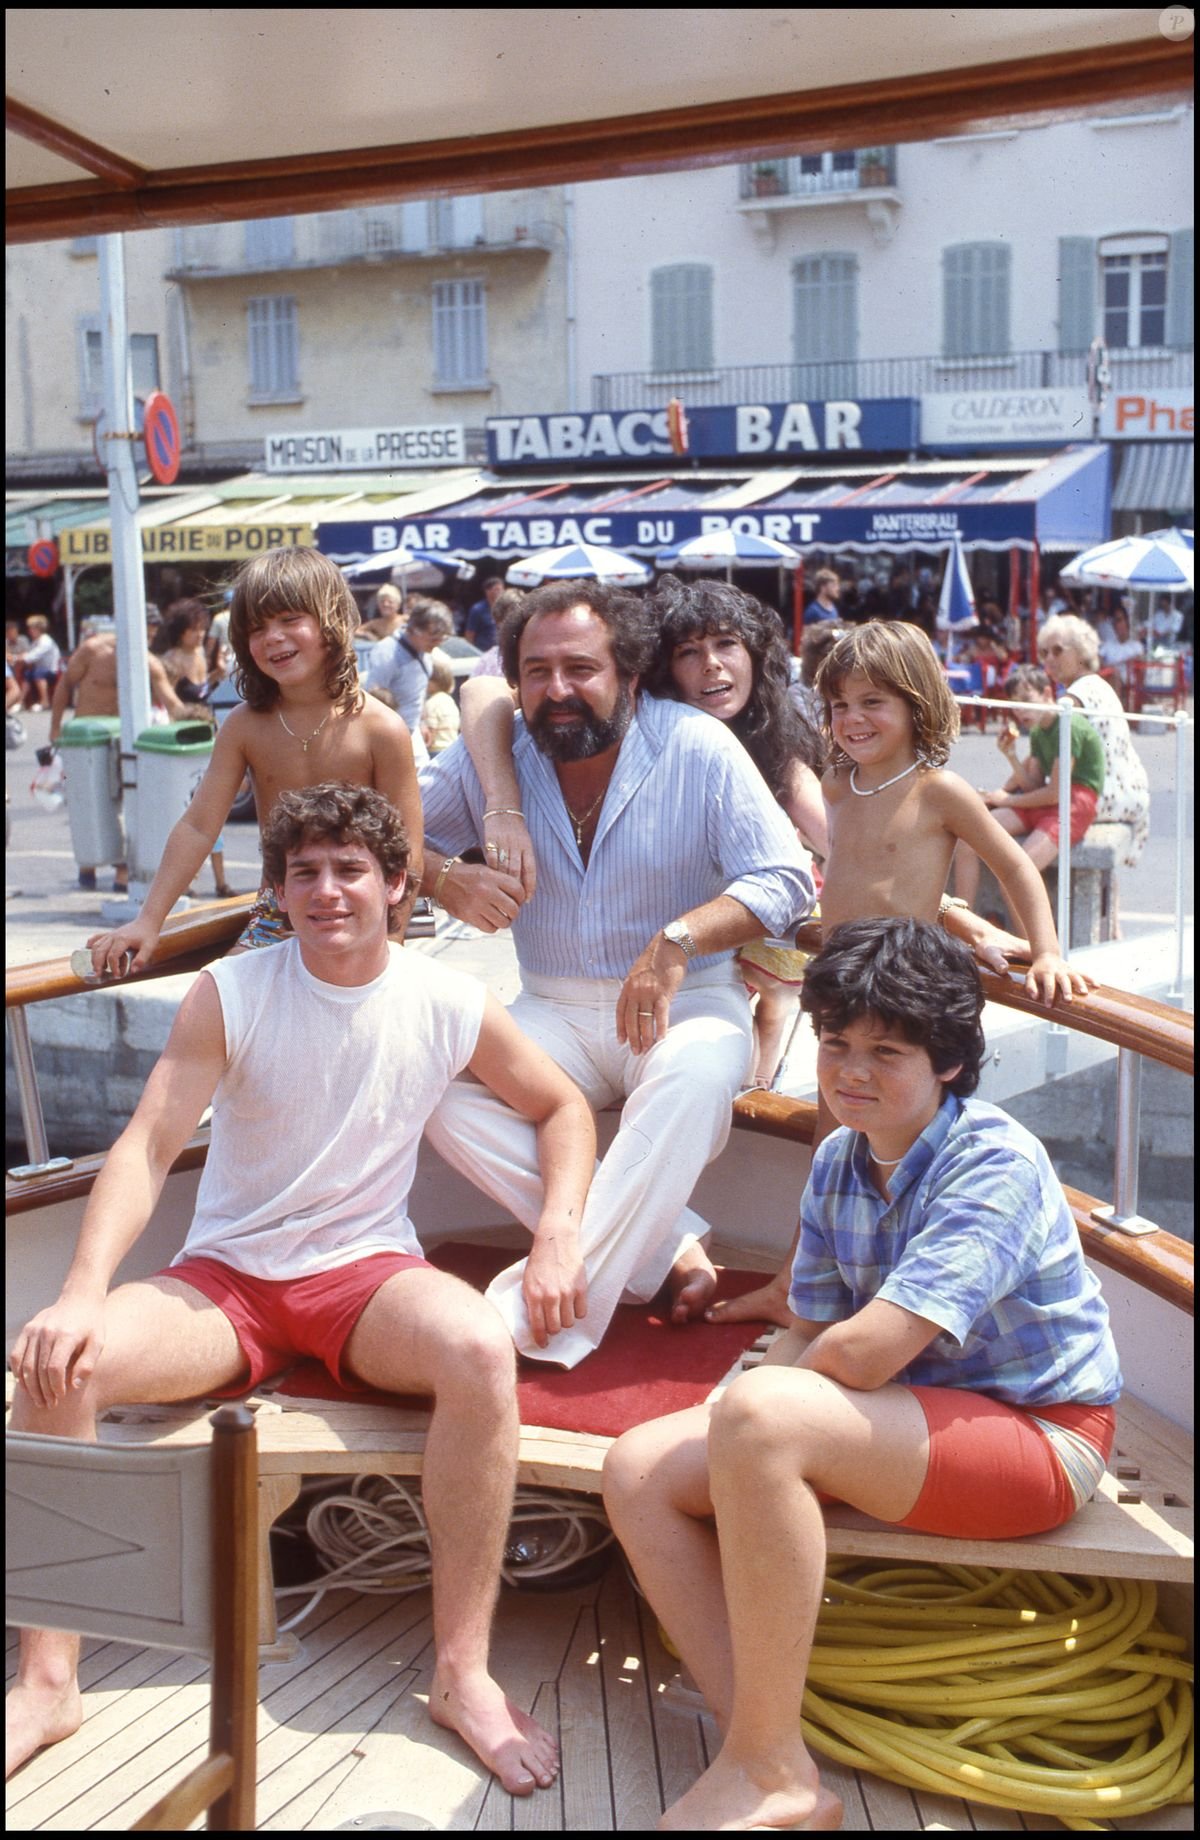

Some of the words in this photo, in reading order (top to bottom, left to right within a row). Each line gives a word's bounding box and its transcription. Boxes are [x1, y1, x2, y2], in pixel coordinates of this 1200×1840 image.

[736, 402, 862, 453] BAR
[270, 436, 342, 465] MAISON
[376, 429, 457, 461] PRESSE
[69, 529, 203, 555] LIBIRIE
[225, 526, 302, 550] PORT
[372, 523, 450, 550] BAR
[481, 518, 612, 547] TABAC
[638, 520, 674, 543] DU
[701, 514, 821, 541] PORT
